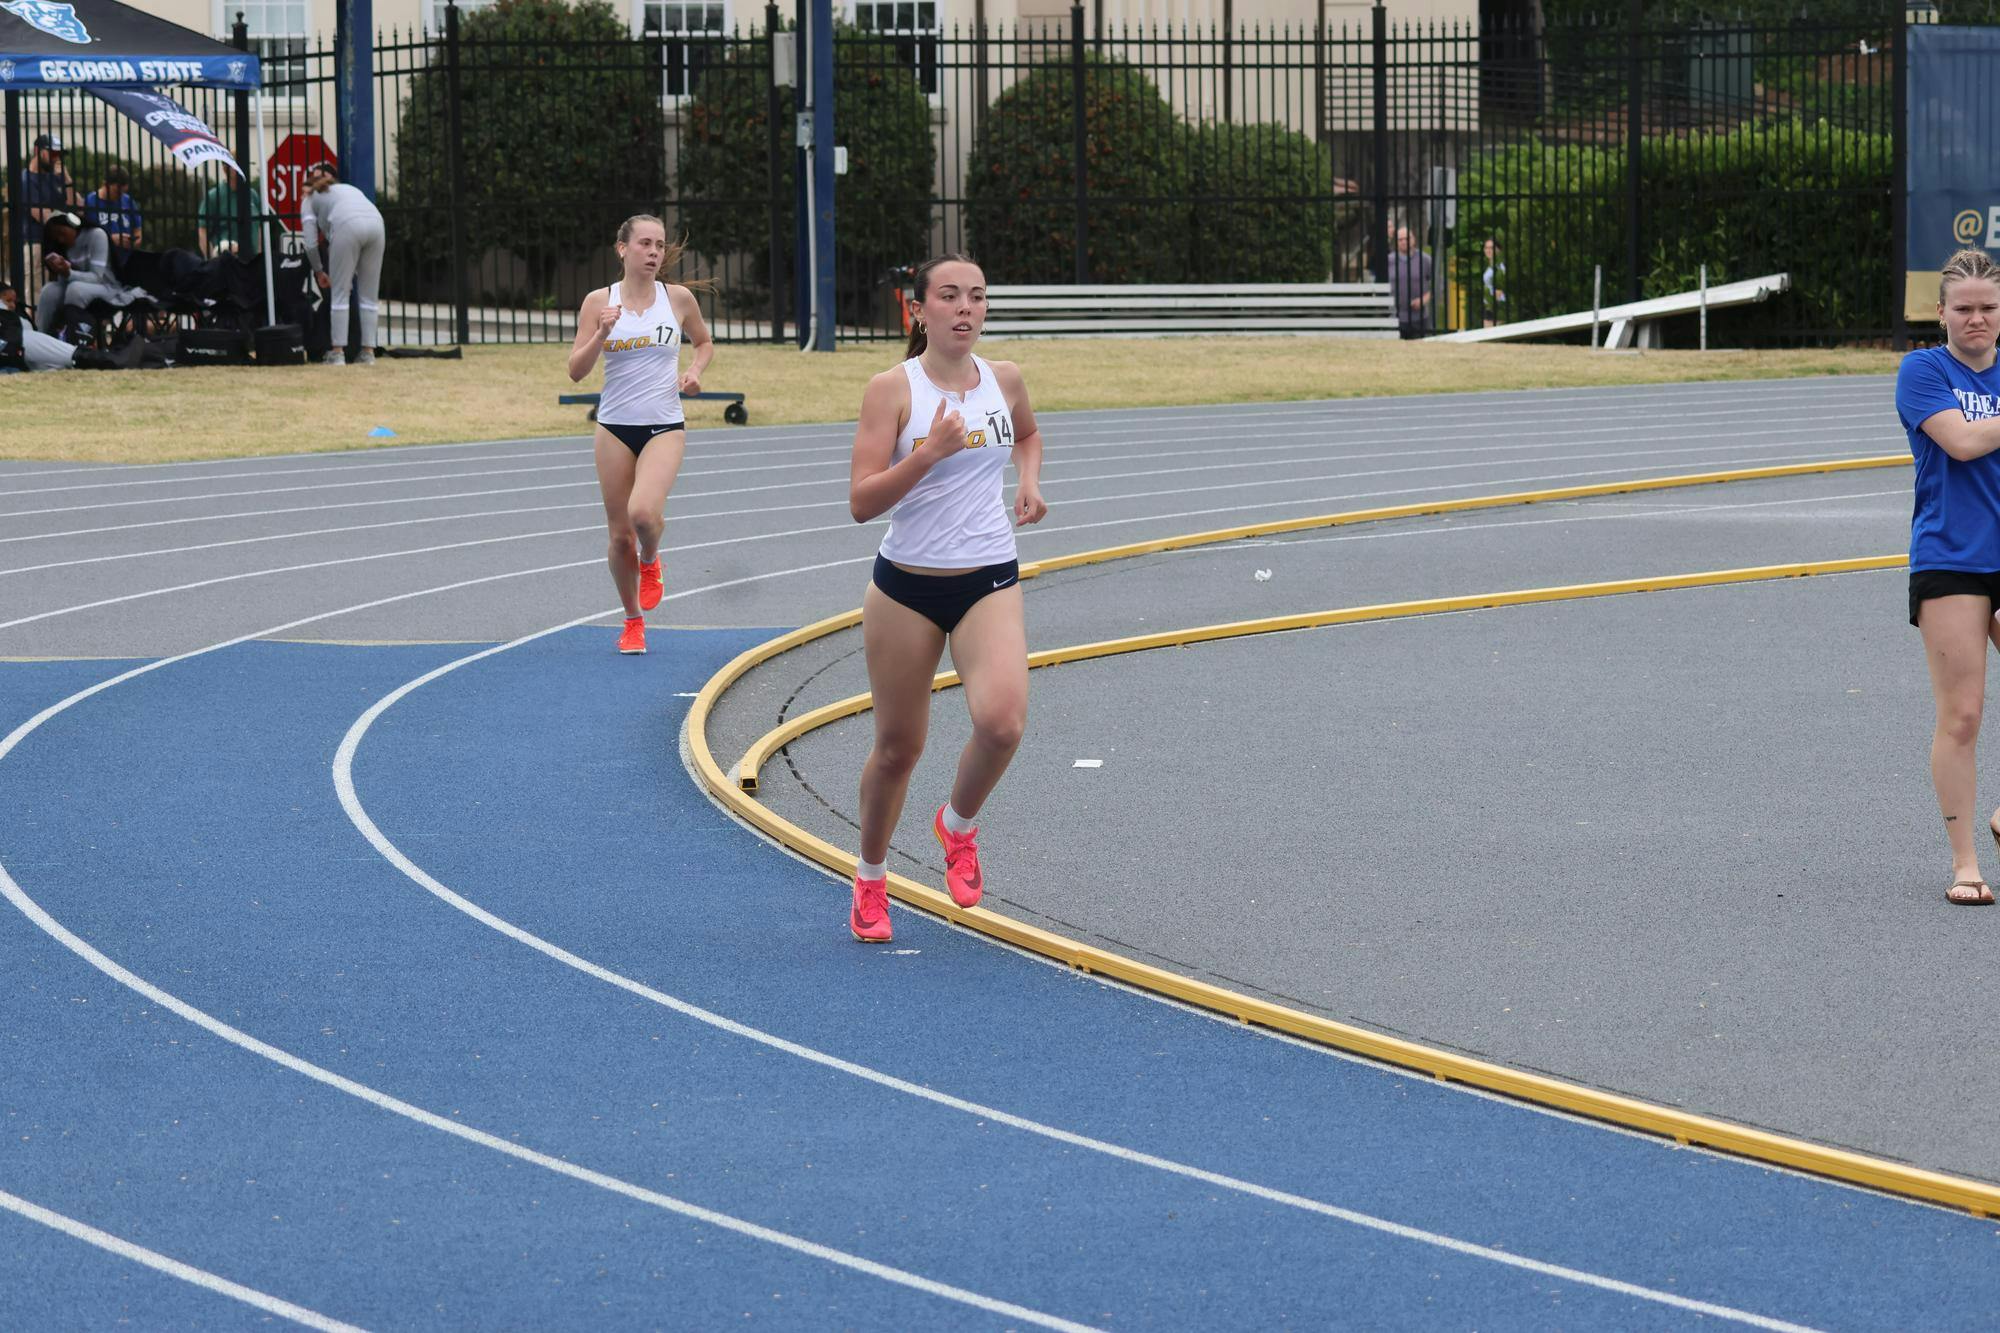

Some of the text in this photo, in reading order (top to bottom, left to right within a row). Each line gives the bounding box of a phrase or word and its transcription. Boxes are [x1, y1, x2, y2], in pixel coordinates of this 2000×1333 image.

[39, 60, 204, 83] GEORGIA STATE
[271, 163, 314, 202] ST
[656, 325, 674, 345] 17
[987, 415, 1012, 445] 14
